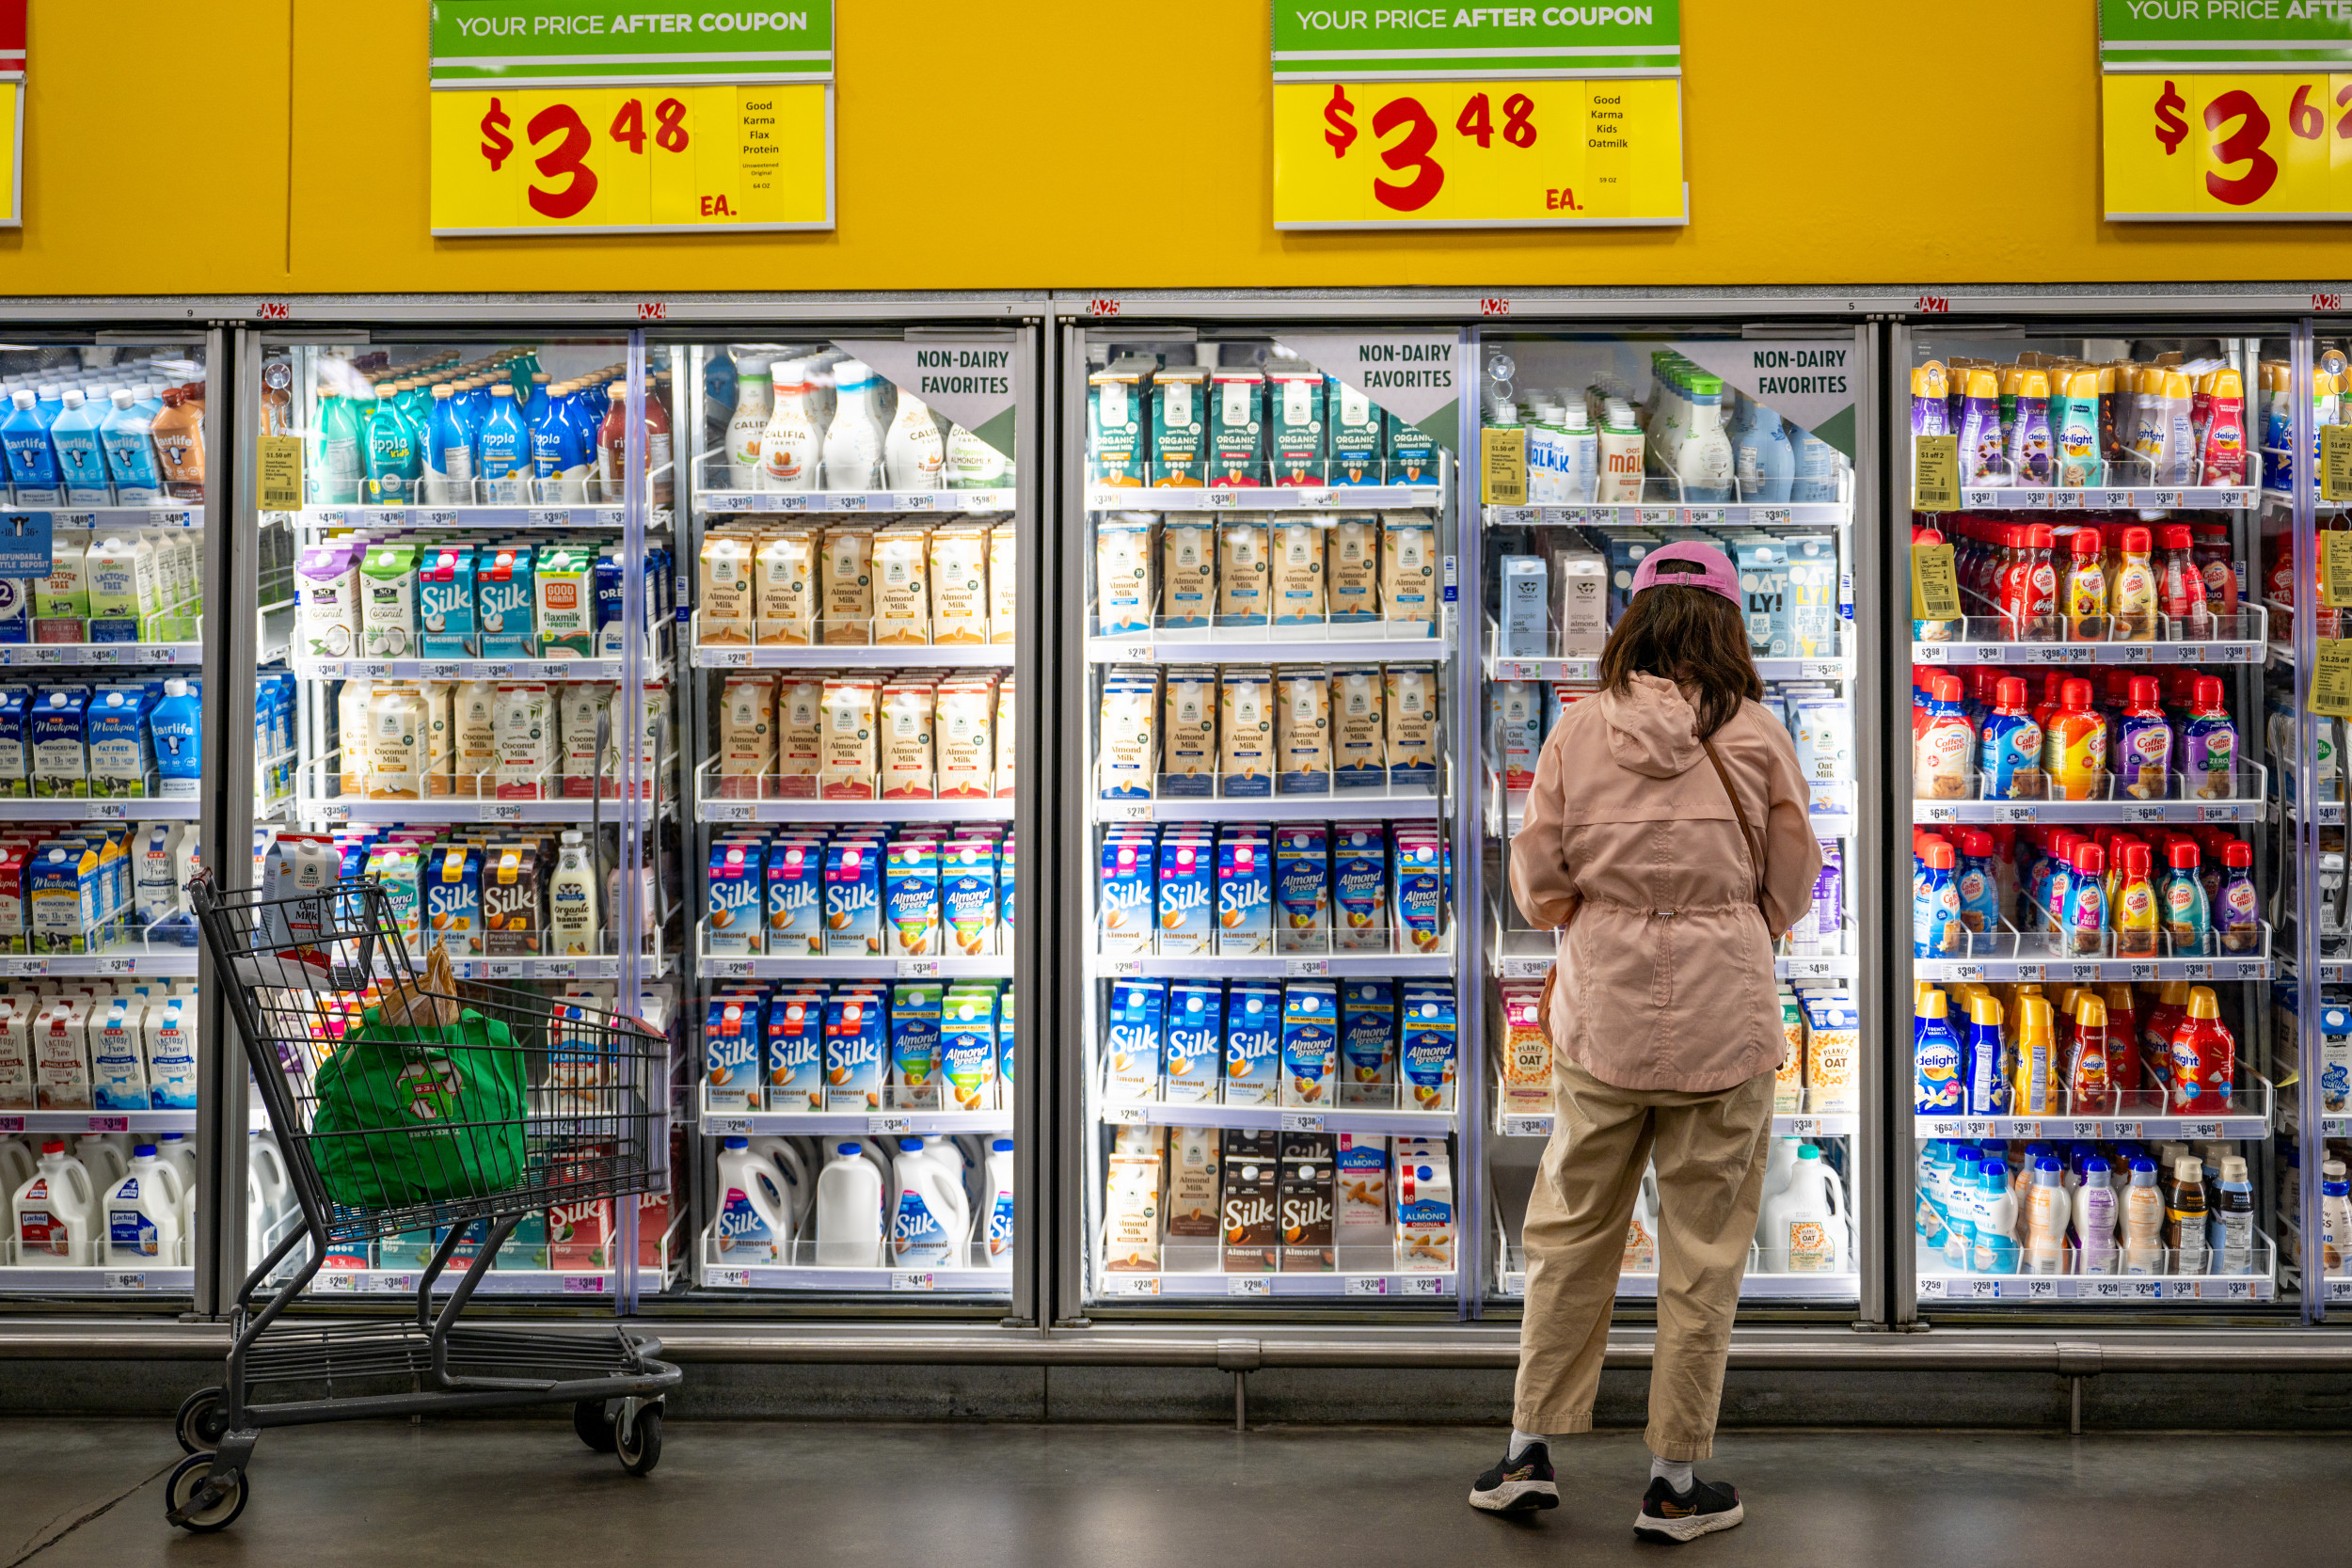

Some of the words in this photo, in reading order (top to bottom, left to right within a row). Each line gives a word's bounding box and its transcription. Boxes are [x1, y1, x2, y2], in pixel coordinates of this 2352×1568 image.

[2127, 0, 2199, 19] YOUR
[2208, 0, 2279, 19] PRICE
[457, 17, 526, 37] YOUR
[534, 16, 604, 35] PRICE
[611, 14, 692, 34] AFTER
[698, 11, 806, 32] COUPON
[1296, 11, 1367, 30] YOUR
[1375, 9, 1447, 28] PRICE
[1454, 8, 1536, 27] AFTER
[1542, 6, 1652, 25] COUPON
[746, 101, 772, 110] Good
[1594, 95, 1621, 104] Good
[744, 116, 775, 124] Karma
[1591, 110, 1623, 119] Karma
[750, 130, 770, 139] Flax
[1597, 124, 1617, 134] Kids
[743, 145, 779, 154] Protein
[1588, 139, 1628, 149] Oatmilk
[701, 195, 737, 216] EA.
[1546, 189, 1583, 211] EA.
[1092, 300, 1120, 315] A25
[1482, 300, 1509, 315] A26
[1920, 297, 1948, 312] A27
[2312, 295, 2341, 309] A28
[262, 304, 289, 319] A23
[639, 304, 665, 319] A24
[917, 351, 1009, 368] NON-DAIRY
[1359, 344, 1451, 362] NON-DAIRY
[1755, 351, 1846, 368] NON-DAIRY
[922, 377, 1009, 393] FAVORITES
[1364, 370, 1451, 388] FAVORITES
[1759, 376, 1847, 393] FAVORITES
[483, 434, 516, 448] ripple
[1158, 436, 1198, 445] ORGANIC
[1216, 436, 1256, 445] ORGANIC
[2058, 434, 2093, 445] delight
[2215, 431, 2240, 441] delight
[95, 573, 130, 583] LACTOSE
[548, 585, 574, 596] GOOD
[708, 593, 740, 601] Almond
[831, 588, 863, 596] Almond
[548, 594, 574, 603] KARMA
[1749, 594, 1783, 613] LY!
[544, 612, 580, 622] flaxmilk
[1513, 611, 1536, 623] simple
[426, 635, 462, 643] Coconut
[485, 635, 521, 643] Coconut
[830, 742, 862, 751] Almond
[1934, 736, 1964, 749] Coffee
[1942, 742, 1964, 752] mate
[375, 748, 408, 756] Coconut
[837, 750, 855, 758] Milk
[710, 880, 759, 913] Silk
[769, 880, 819, 913] Silk
[891, 890, 934, 906] Almond
[947, 888, 990, 905] Almond
[1219, 879, 1270, 912] Silk
[554, 905, 590, 915] Organic
[898, 899, 928, 912] Breeze
[955, 898, 984, 911] Breeze
[707, 1037, 756, 1069] Silk
[827, 1037, 877, 1069] Silk
[1518, 1044, 1544, 1054] PLANET
[1518, 1054, 1542, 1066] OAT
[1824, 1057, 1848, 1069] OAT
[1915, 1053, 1959, 1067] delight
[1404, 1175, 1414, 1183] 60
[1224, 1197, 1275, 1231] Silk
